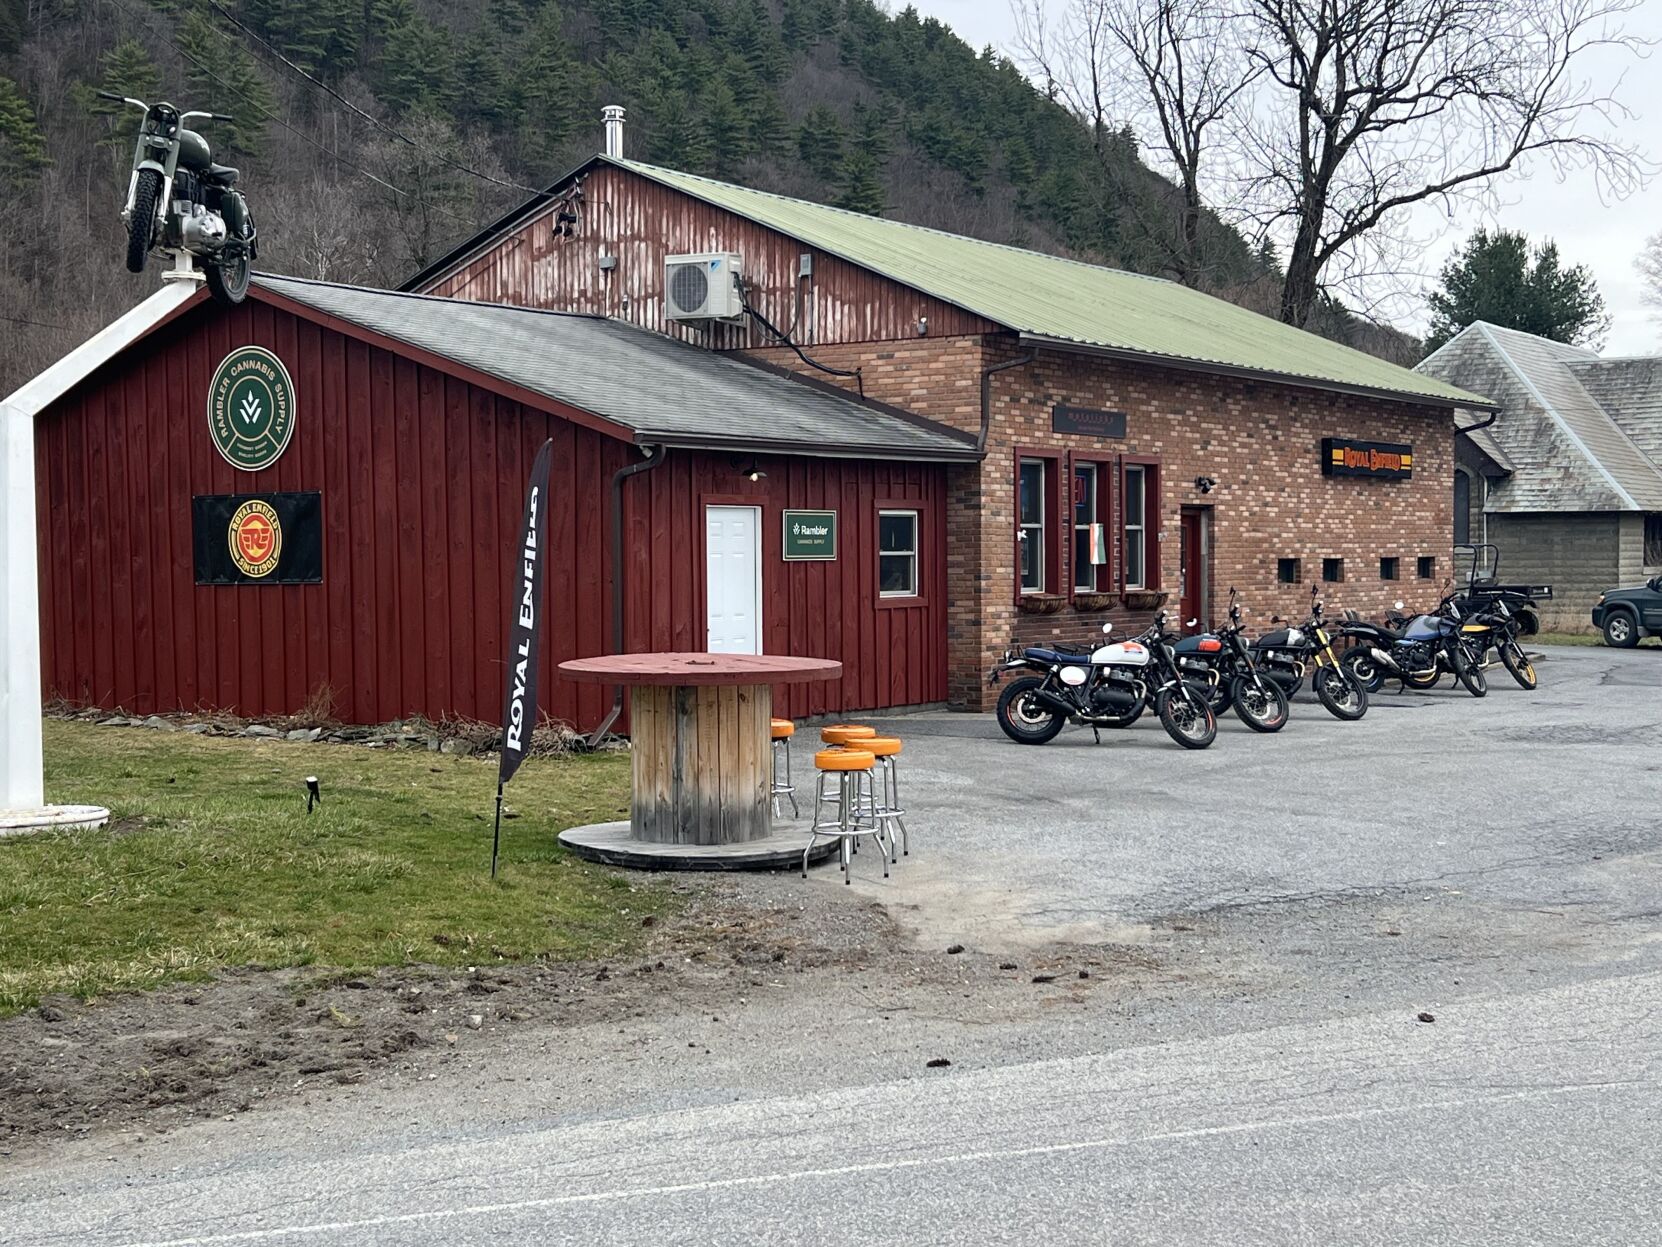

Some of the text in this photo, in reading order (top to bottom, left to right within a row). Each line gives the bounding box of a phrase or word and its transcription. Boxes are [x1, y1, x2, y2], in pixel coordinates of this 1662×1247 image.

[216, 360, 286, 438] RAMBLER CANNABIS SUPPLY
[1344, 446, 1401, 472] ROYAL ENFIELD
[232, 503, 278, 531] ROYAL ENFIELD
[801, 525, 829, 536] Rambler
[238, 557, 276, 574] SINCE 1901
[507, 638, 530, 752] ROYAL
